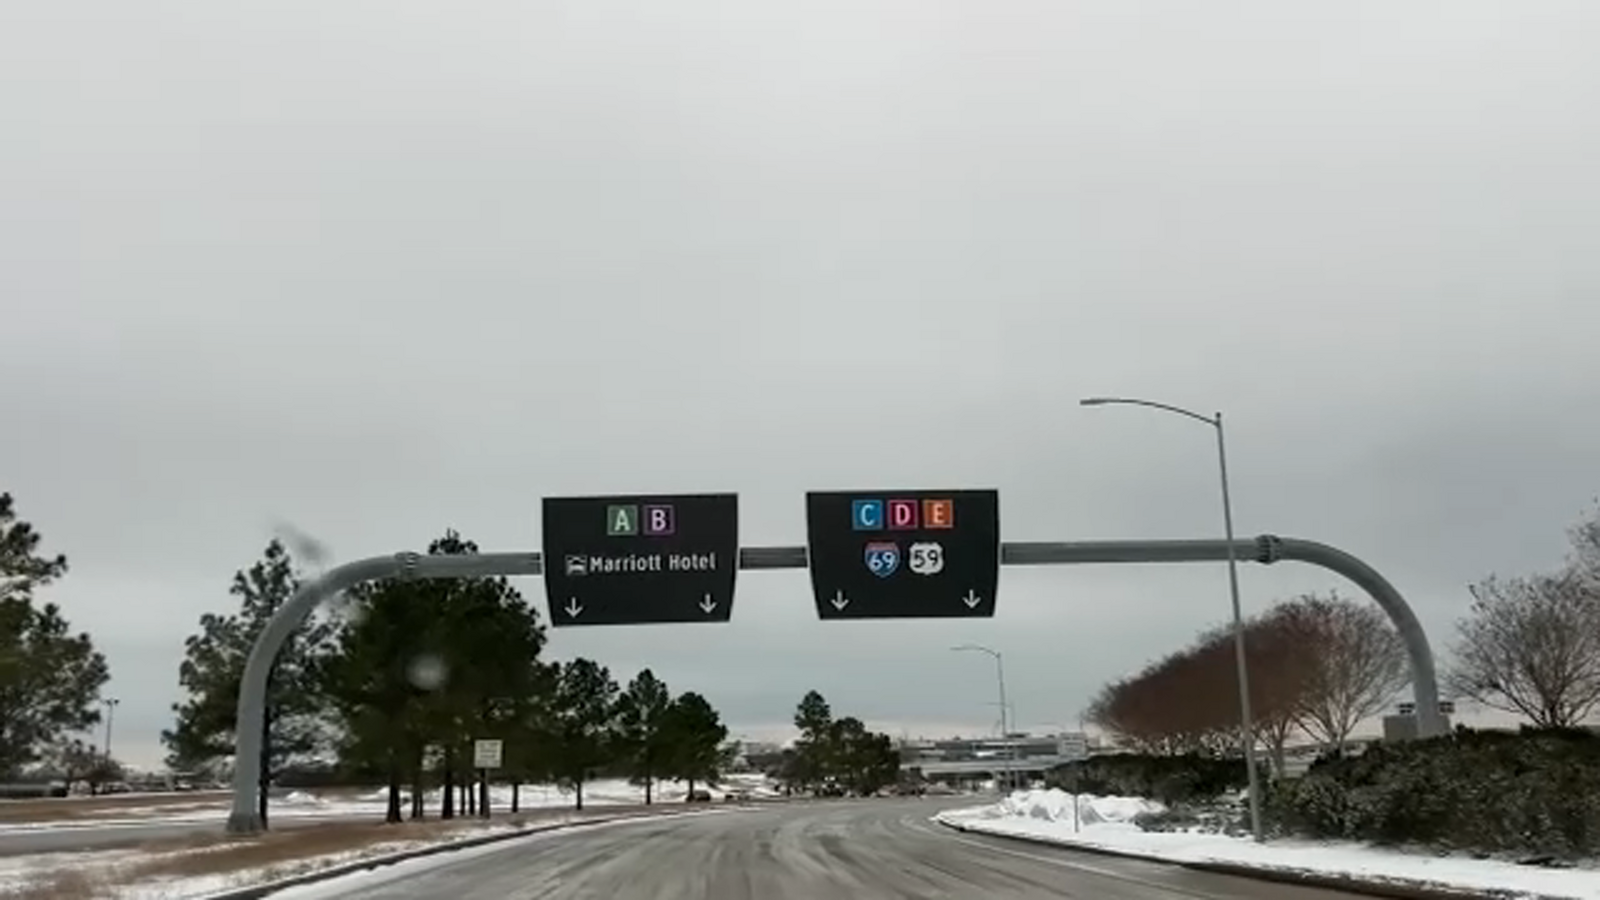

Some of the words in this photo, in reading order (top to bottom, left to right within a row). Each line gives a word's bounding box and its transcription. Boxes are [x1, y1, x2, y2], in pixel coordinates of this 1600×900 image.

[614, 509, 631, 531] A
[651, 508, 667, 531] B
[860, 504, 875, 526] C
[895, 504, 911, 525] D
[932, 503, 945, 524] E
[589, 554, 661, 572] Marriott
[669, 552, 716, 570] Hotel
[869, 551, 896, 571] 69
[913, 549, 939, 568] 59
